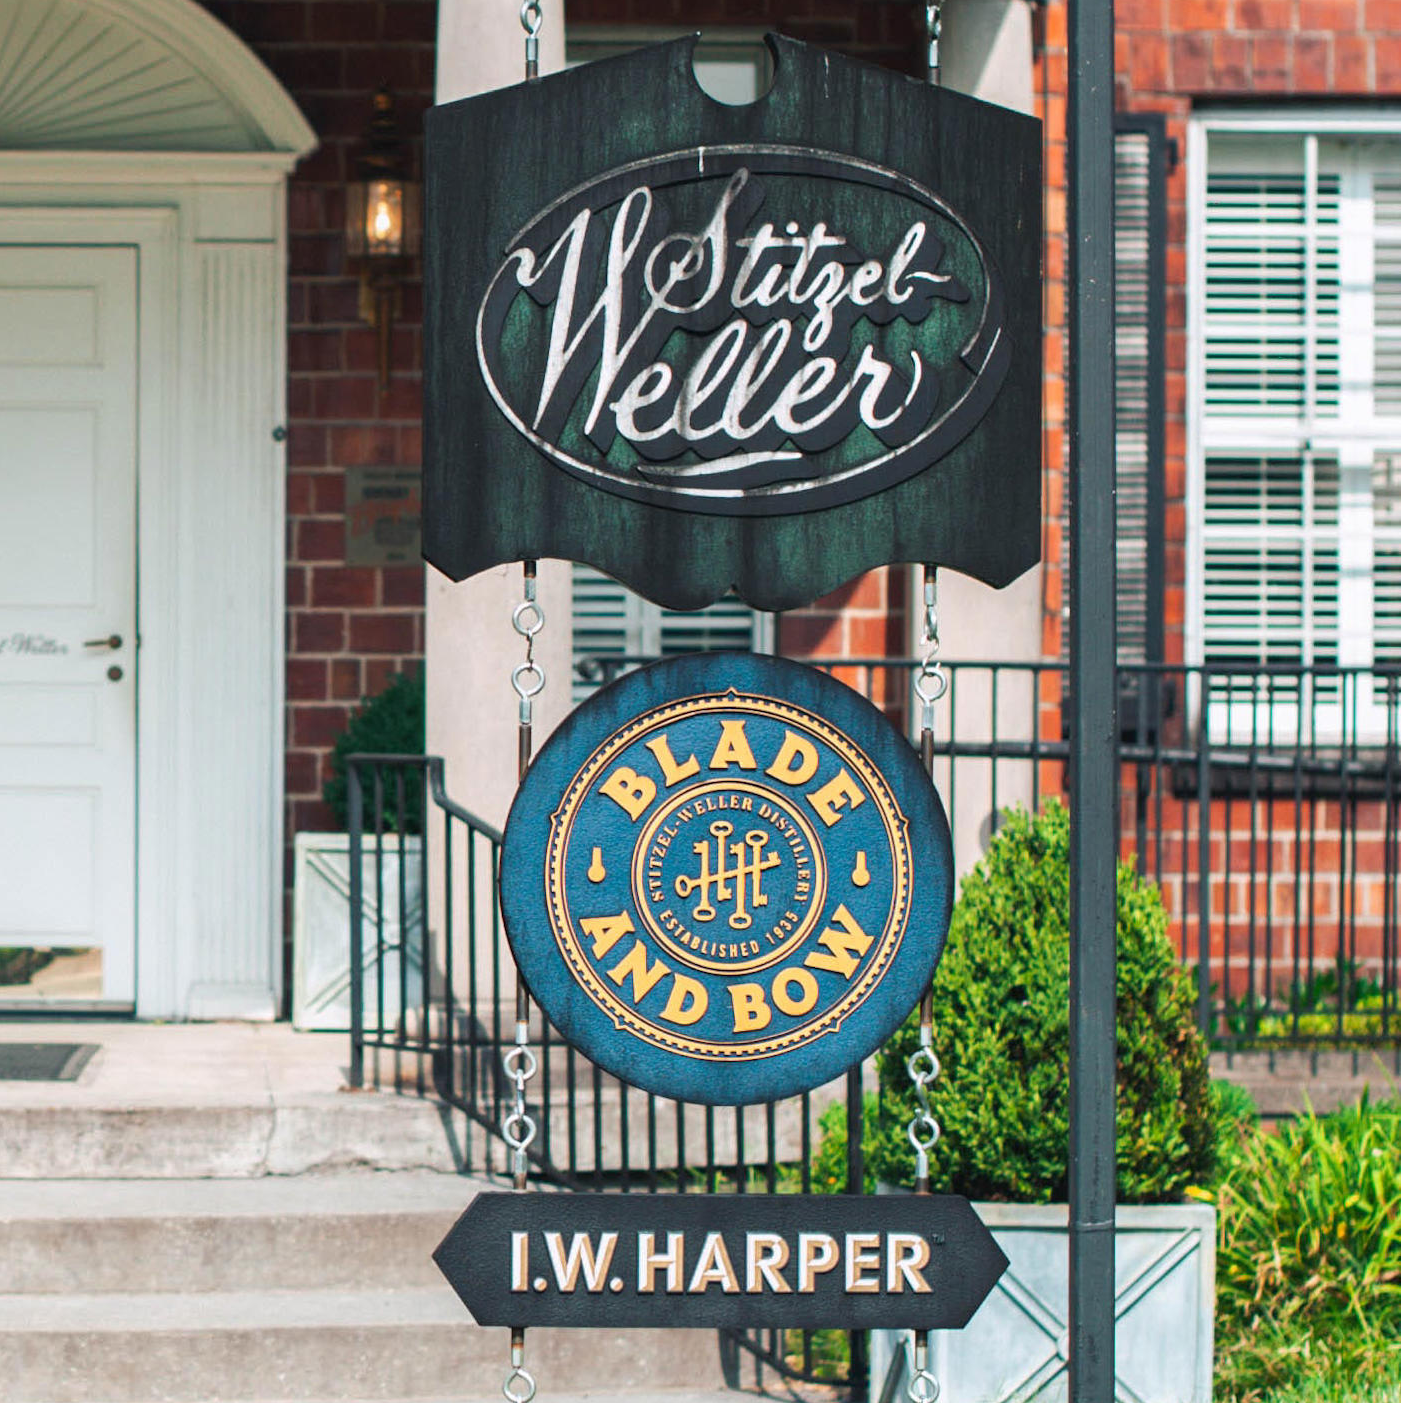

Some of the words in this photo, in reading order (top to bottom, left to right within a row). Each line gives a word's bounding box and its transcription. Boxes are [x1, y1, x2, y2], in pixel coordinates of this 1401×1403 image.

[511, 186, 923, 442] Weller
[599, 719, 867, 828] BLADE
[648, 794, 754, 903] STITZEL-WELLER
[579, 909, 710, 1026] AND
[727, 903, 876, 1034] BOW
[659, 909, 760, 959] ESTABLISHED
[764, 910, 800, 946] 1935
[636, 1230, 933, 1294] HARPER
